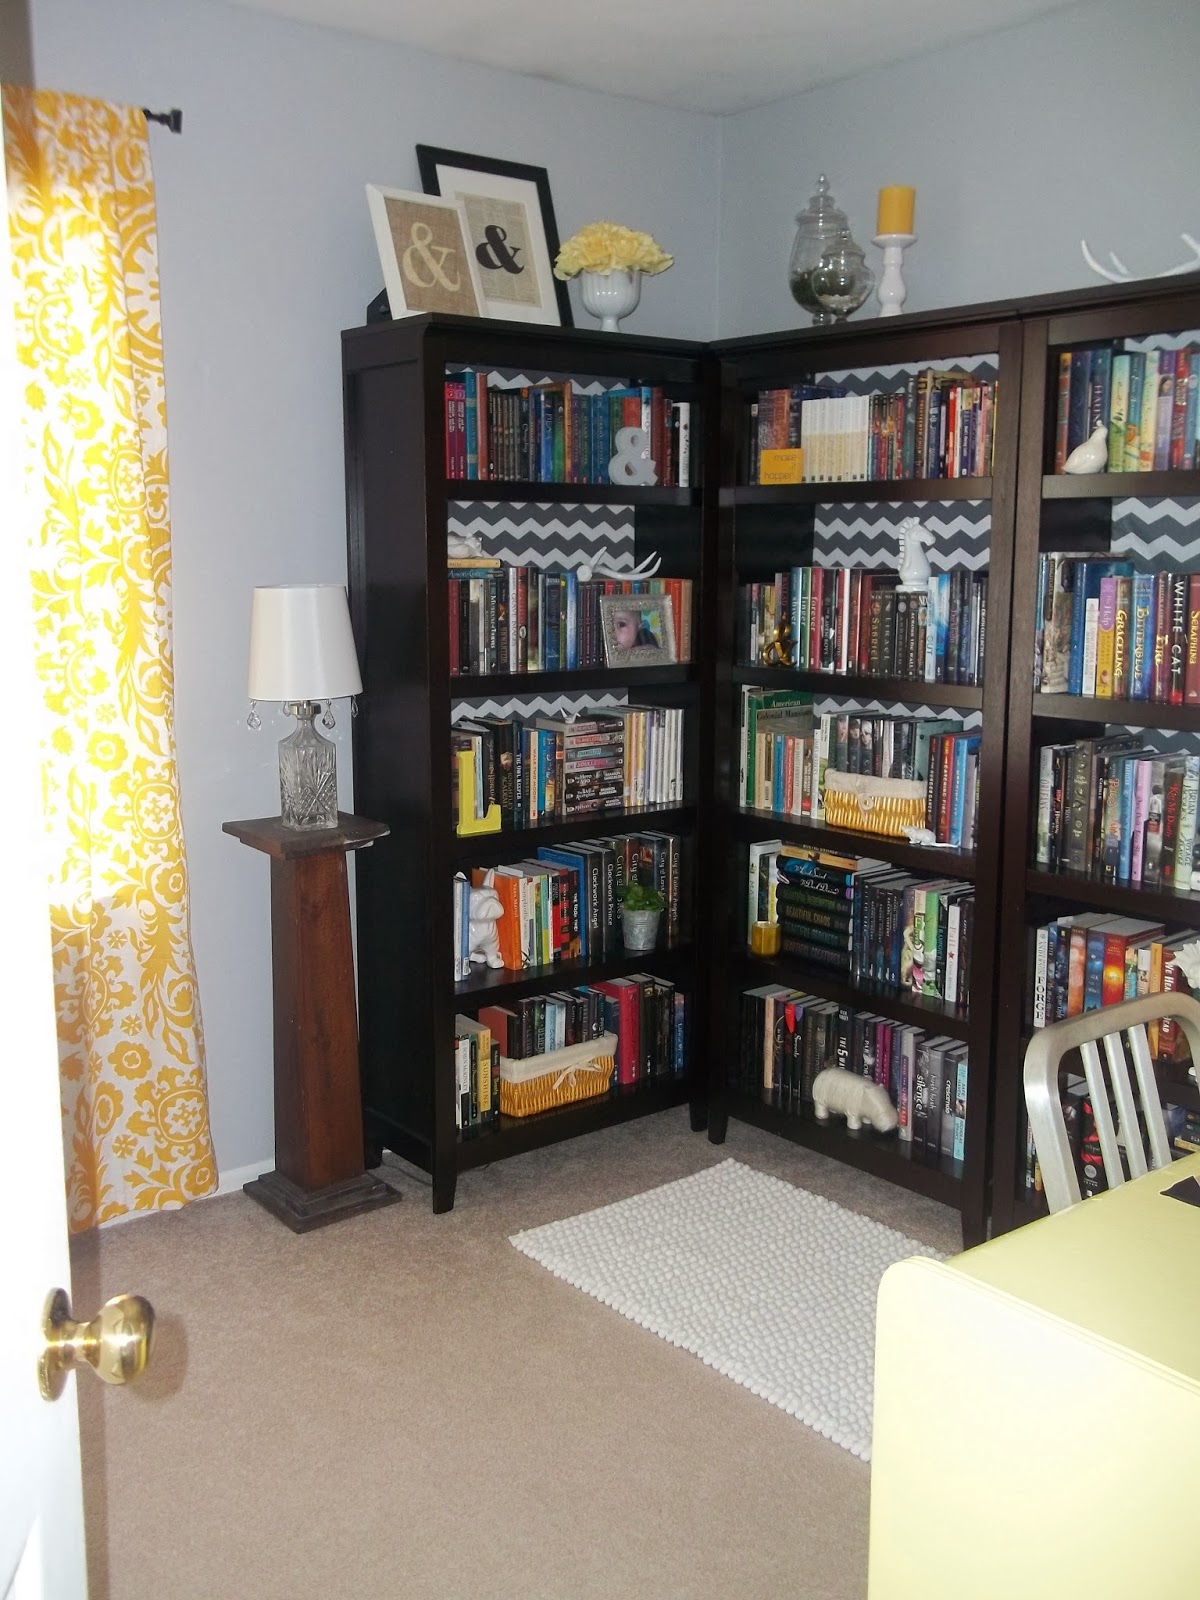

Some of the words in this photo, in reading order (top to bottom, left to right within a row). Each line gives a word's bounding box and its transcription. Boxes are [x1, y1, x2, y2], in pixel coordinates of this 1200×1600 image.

[403, 222, 461, 292] &
[476, 225, 525, 274] &
[800, 596, 808, 626] linger
[1103, 606, 1112, 626] Help
[1173, 581, 1184, 633] WHITE
[871, 617, 879, 660] SABRIEL
[884, 617, 892, 661] LIRAEL
[1114, 610, 1127, 678] GRACELING
[1134, 606, 1149, 679] BITTERBLUE
[1155, 634, 1168, 667] FIRE
[1189, 611, 1200, 664] SERAPHINA
[1171, 645, 1181, 675] CAT
[771, 700, 801, 708] American
[1040, 779, 1049, 810] ORLEANS
[1167, 785, 1179, 800] Kiss
[1188, 789, 1197, 815] BRIAN
[1168, 804, 1176, 814] Me
[1166, 815, 1175, 838] Deadly
[616, 855, 624, 876] City
[630, 853, 638, 872] City
[591, 908, 599, 928] Angel
[814, 913, 831, 927] CHAOS
[949, 927, 957, 948] Fall
[1036, 976, 1045, 1020] FORGE
[1164, 976, 1174, 992] HEA
[837, 1049, 848, 1057] 5
[915, 1074, 926, 1110] silence
